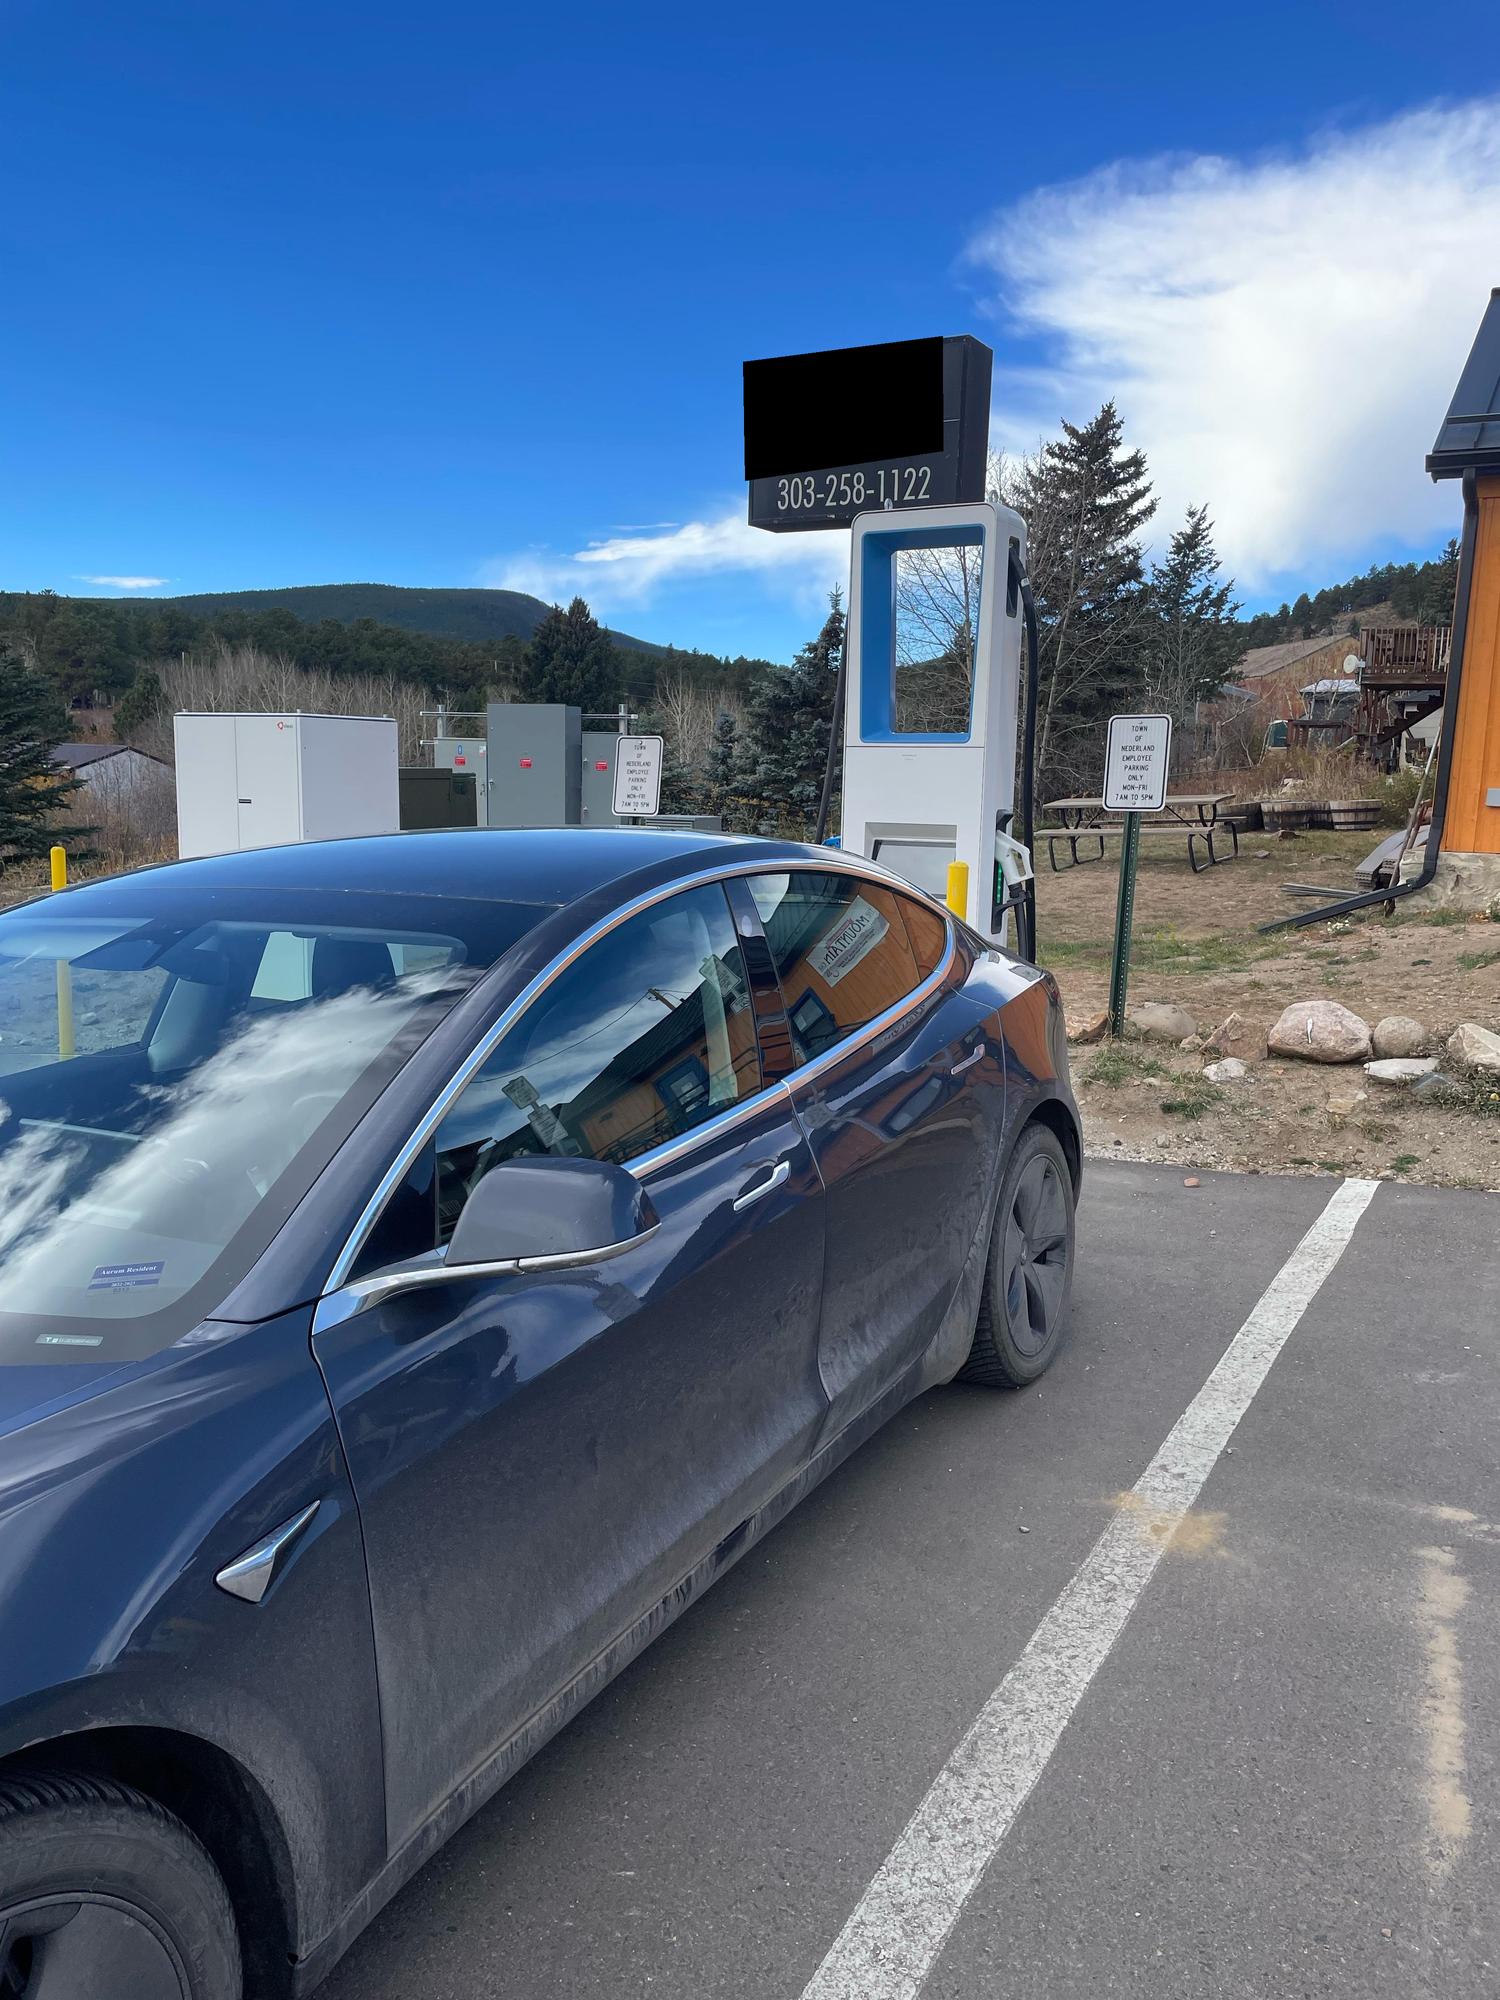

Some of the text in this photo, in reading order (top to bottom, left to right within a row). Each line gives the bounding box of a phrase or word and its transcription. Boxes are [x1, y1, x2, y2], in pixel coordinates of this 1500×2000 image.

[777, 466, 931, 511] 303-258-1122
[1115, 793, 1128, 801] 7AM
[1141, 793, 1153, 801] 5PM
[126, 1265, 157, 1273] Resident
